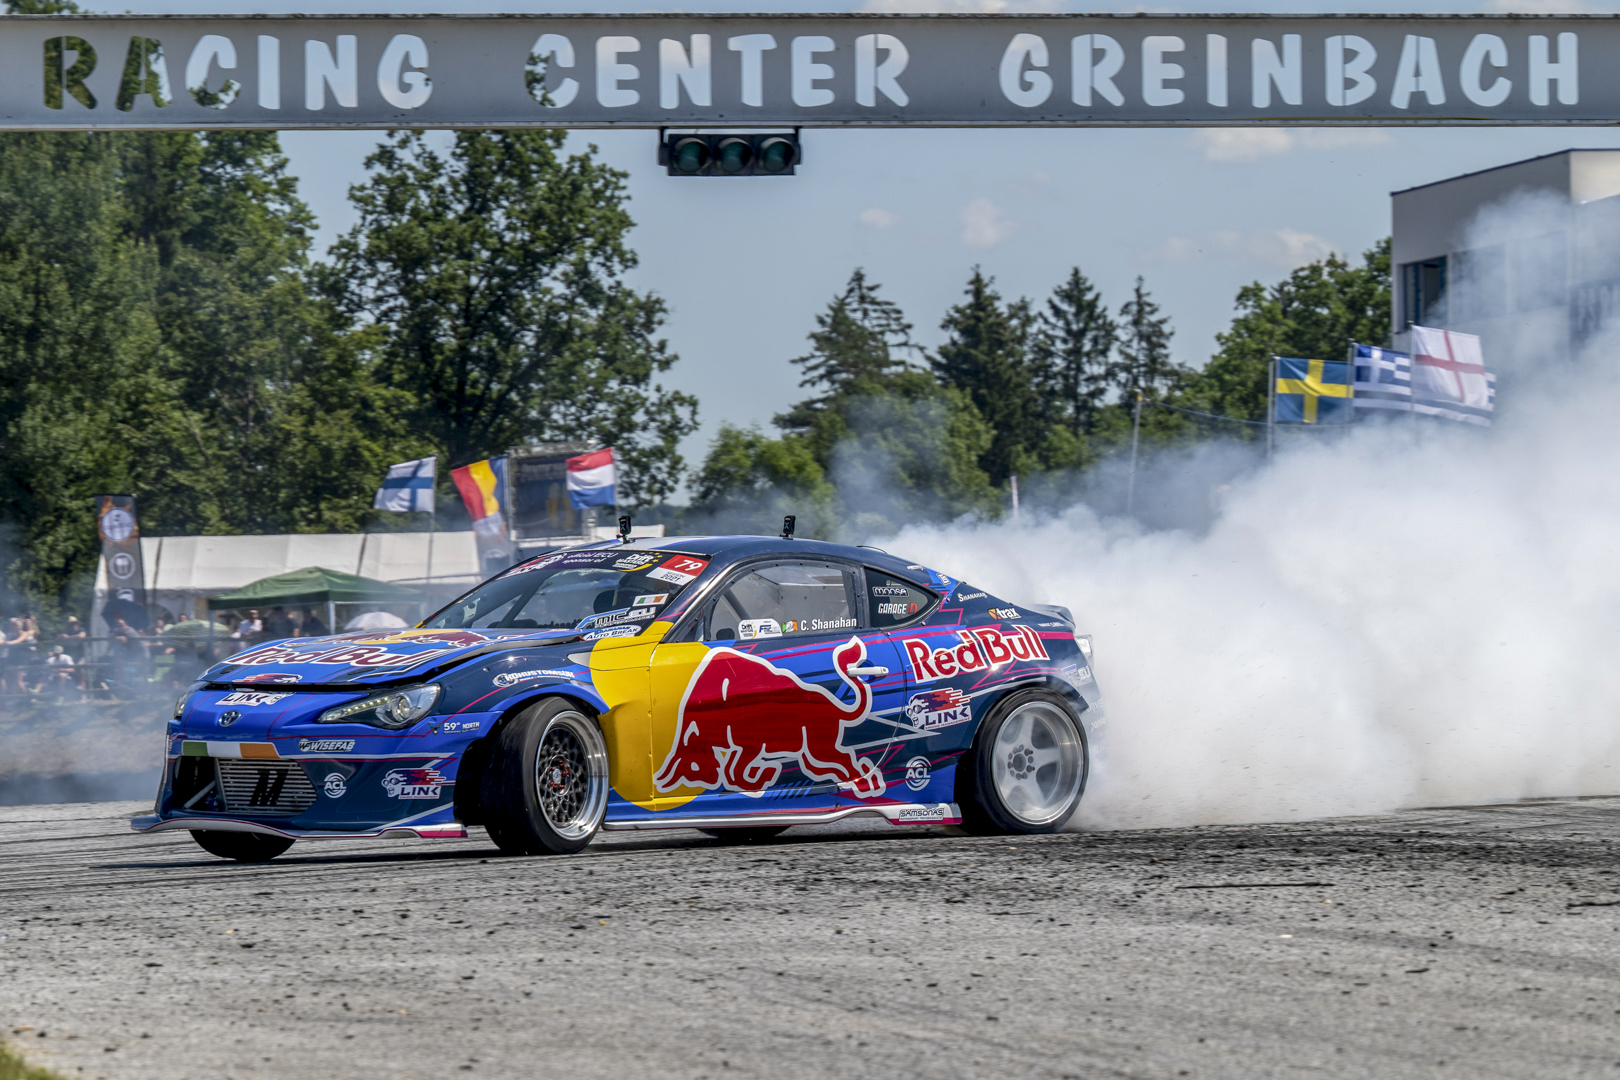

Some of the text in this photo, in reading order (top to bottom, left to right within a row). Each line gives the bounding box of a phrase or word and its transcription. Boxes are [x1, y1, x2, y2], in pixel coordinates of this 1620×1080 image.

[42, 31, 1580, 112] RACING CENTER GREINBACH
[674, 559, 703, 571] 79
[660, 573, 681, 582] 2021
[800, 617, 857, 631] C. Shanahan
[586, 632, 610, 640] AUTO
[611, 627, 639, 636] BREAK
[221, 693, 270, 703] LINK
[925, 705, 970, 726] LINK
[462, 721, 480, 730] NORTH
[310, 741, 356, 750] WISEFAB
[905, 767, 931, 779] ACL
[323, 781, 347, 790] ACL
[400, 786, 440, 796] LINK
[900, 808, 943, 817] SAMSONAS
